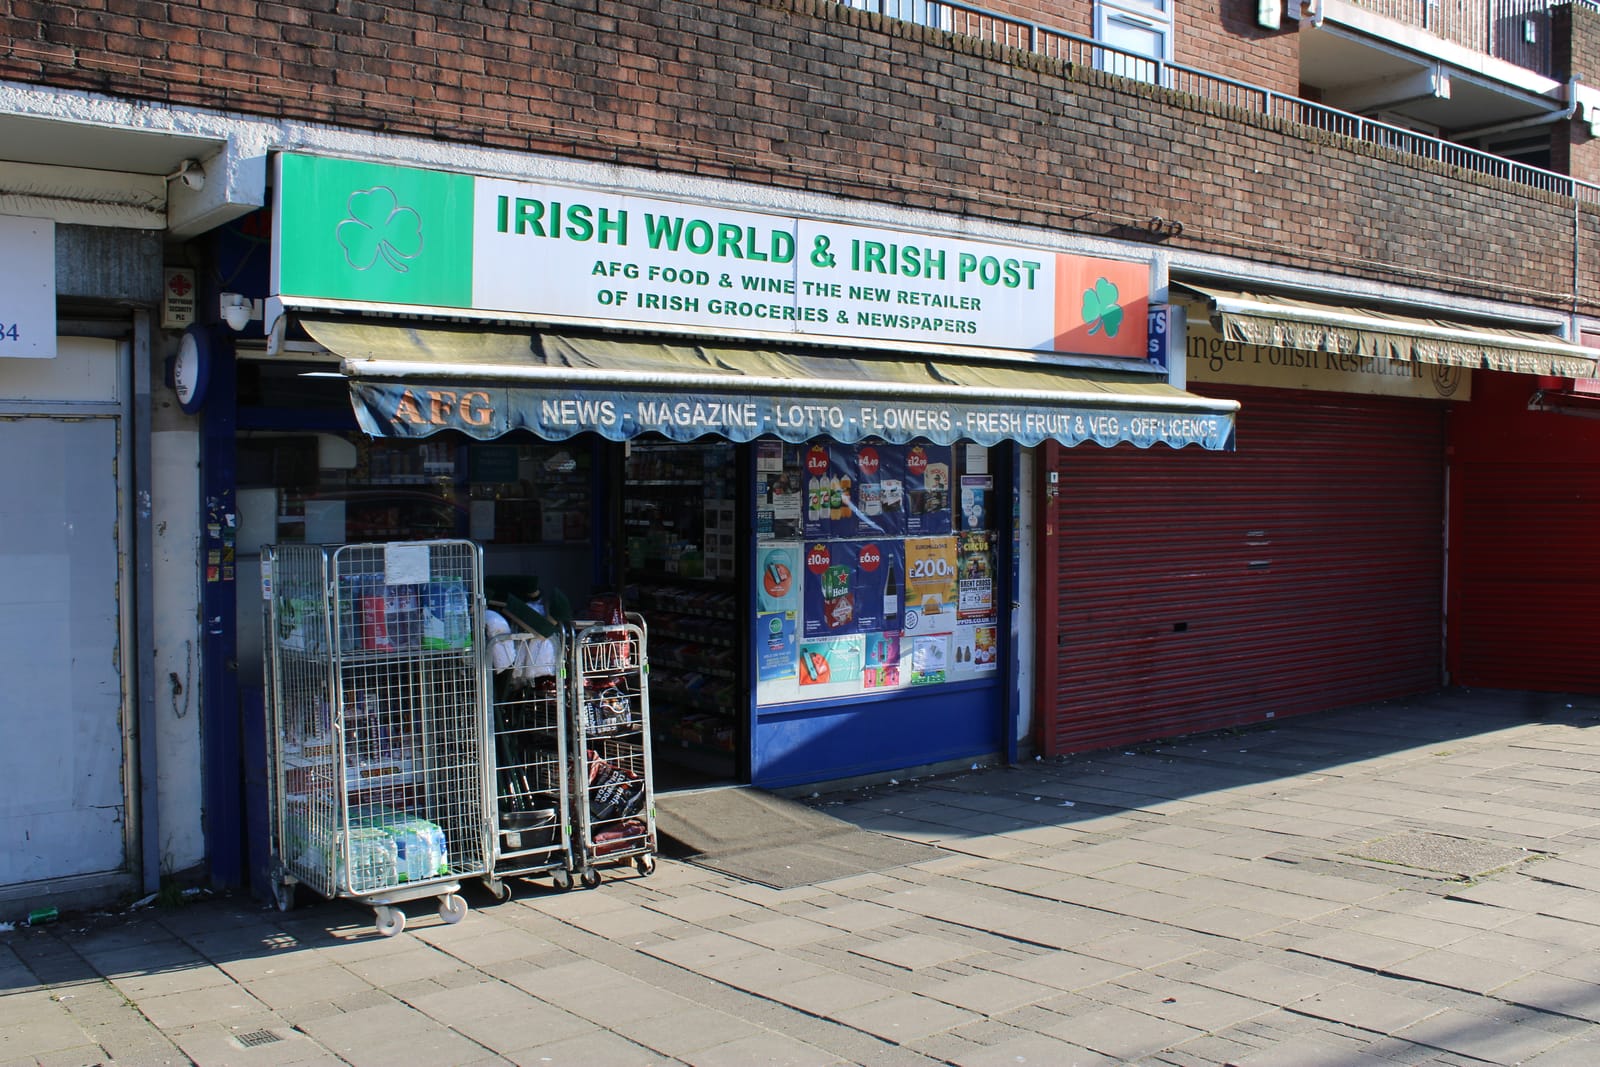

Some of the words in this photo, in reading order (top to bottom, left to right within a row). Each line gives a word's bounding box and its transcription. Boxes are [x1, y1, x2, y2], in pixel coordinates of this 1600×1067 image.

[497, 195, 629, 246] IRISH
[644, 213, 796, 264] WORLD
[810, 234, 837, 269] &
[851, 239, 946, 280] IRISH
[958, 252, 1041, 290] POST
[592, 260, 639, 279] AFG
[648, 266, 710, 286] FOOD
[718, 273, 733, 288] &
[741, 275, 796, 295] WINE
[802, 281, 842, 298] THE
[849, 286, 891, 303] NEW
[897, 290, 982, 311] RETAILER
[597, 289, 628, 307] OF
[637, 293, 699, 313] IRISH
[707, 299, 829, 323] GROCERIES
[836, 310, 849, 325] &
[857, 312, 978, 334] NEWSPAPERS
[1186, 333, 1244, 372] inger
[391, 389, 495, 428] AFG
[542, 399, 616, 426] NEWS
[638, 401, 758, 427] MAGAZINE
[776, 405, 844, 429] LOTTO
[861, 409, 951, 432] FLOWERS
[966, 411, 1022, 433] FRESH
[1027, 413, 1070, 434] FRUIT
[1074, 418, 1085, 434] &
[1089, 416, 1119, 436] VEG
[963, 542, 989, 552] CIRCUS
